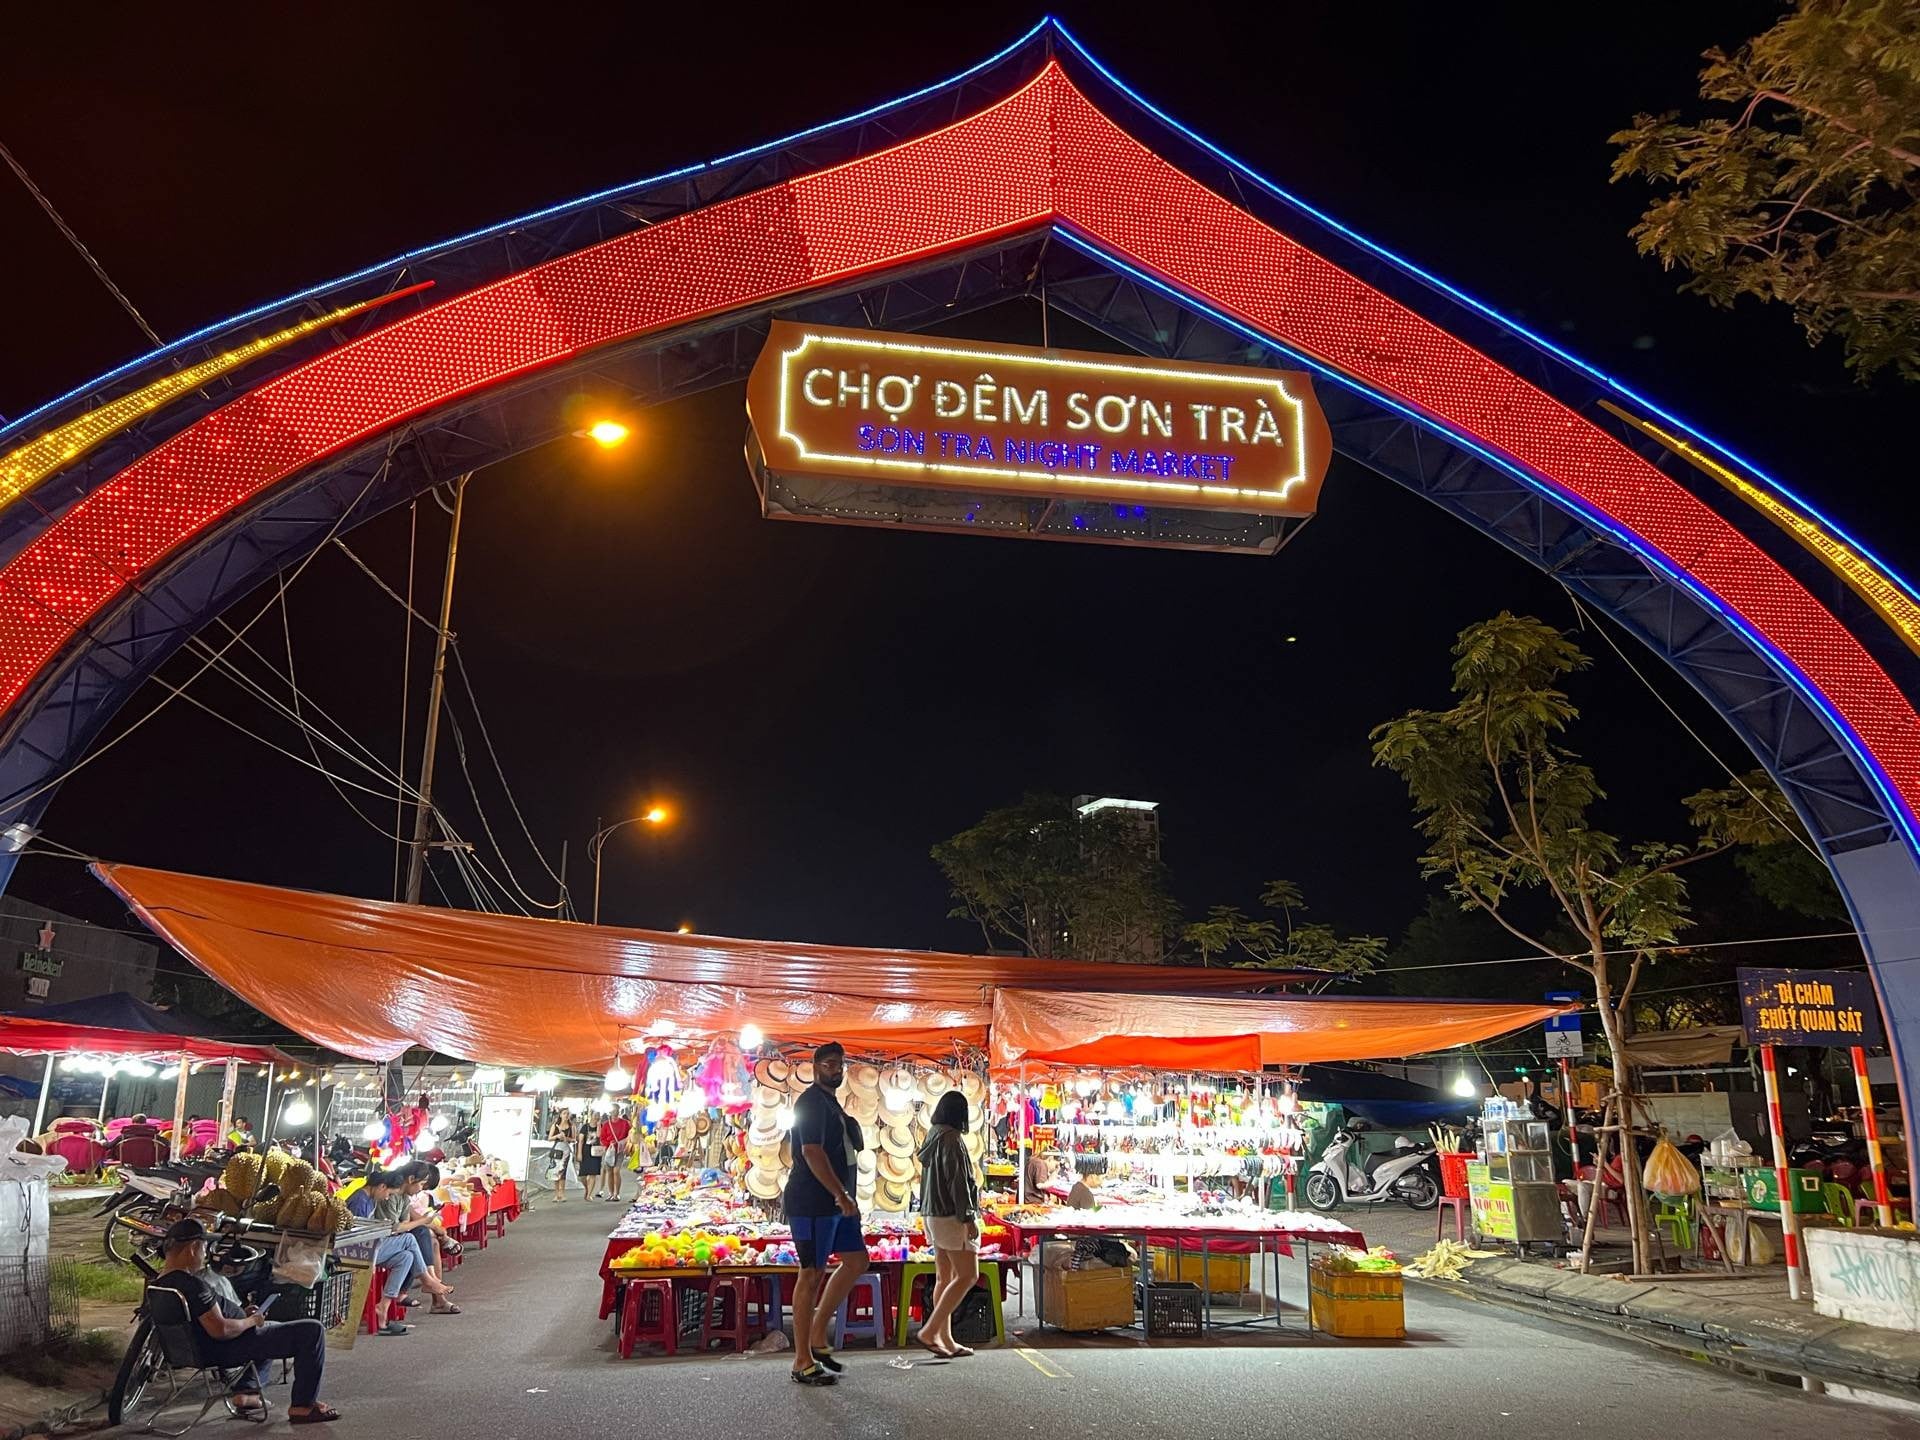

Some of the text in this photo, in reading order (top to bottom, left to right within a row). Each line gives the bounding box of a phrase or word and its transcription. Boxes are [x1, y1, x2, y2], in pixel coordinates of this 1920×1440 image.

[802, 367, 1284, 447] CHỢ ĐÊM SƠN TRÀ
[858, 424, 1235, 481] SON TRA NIGHT MARKET
